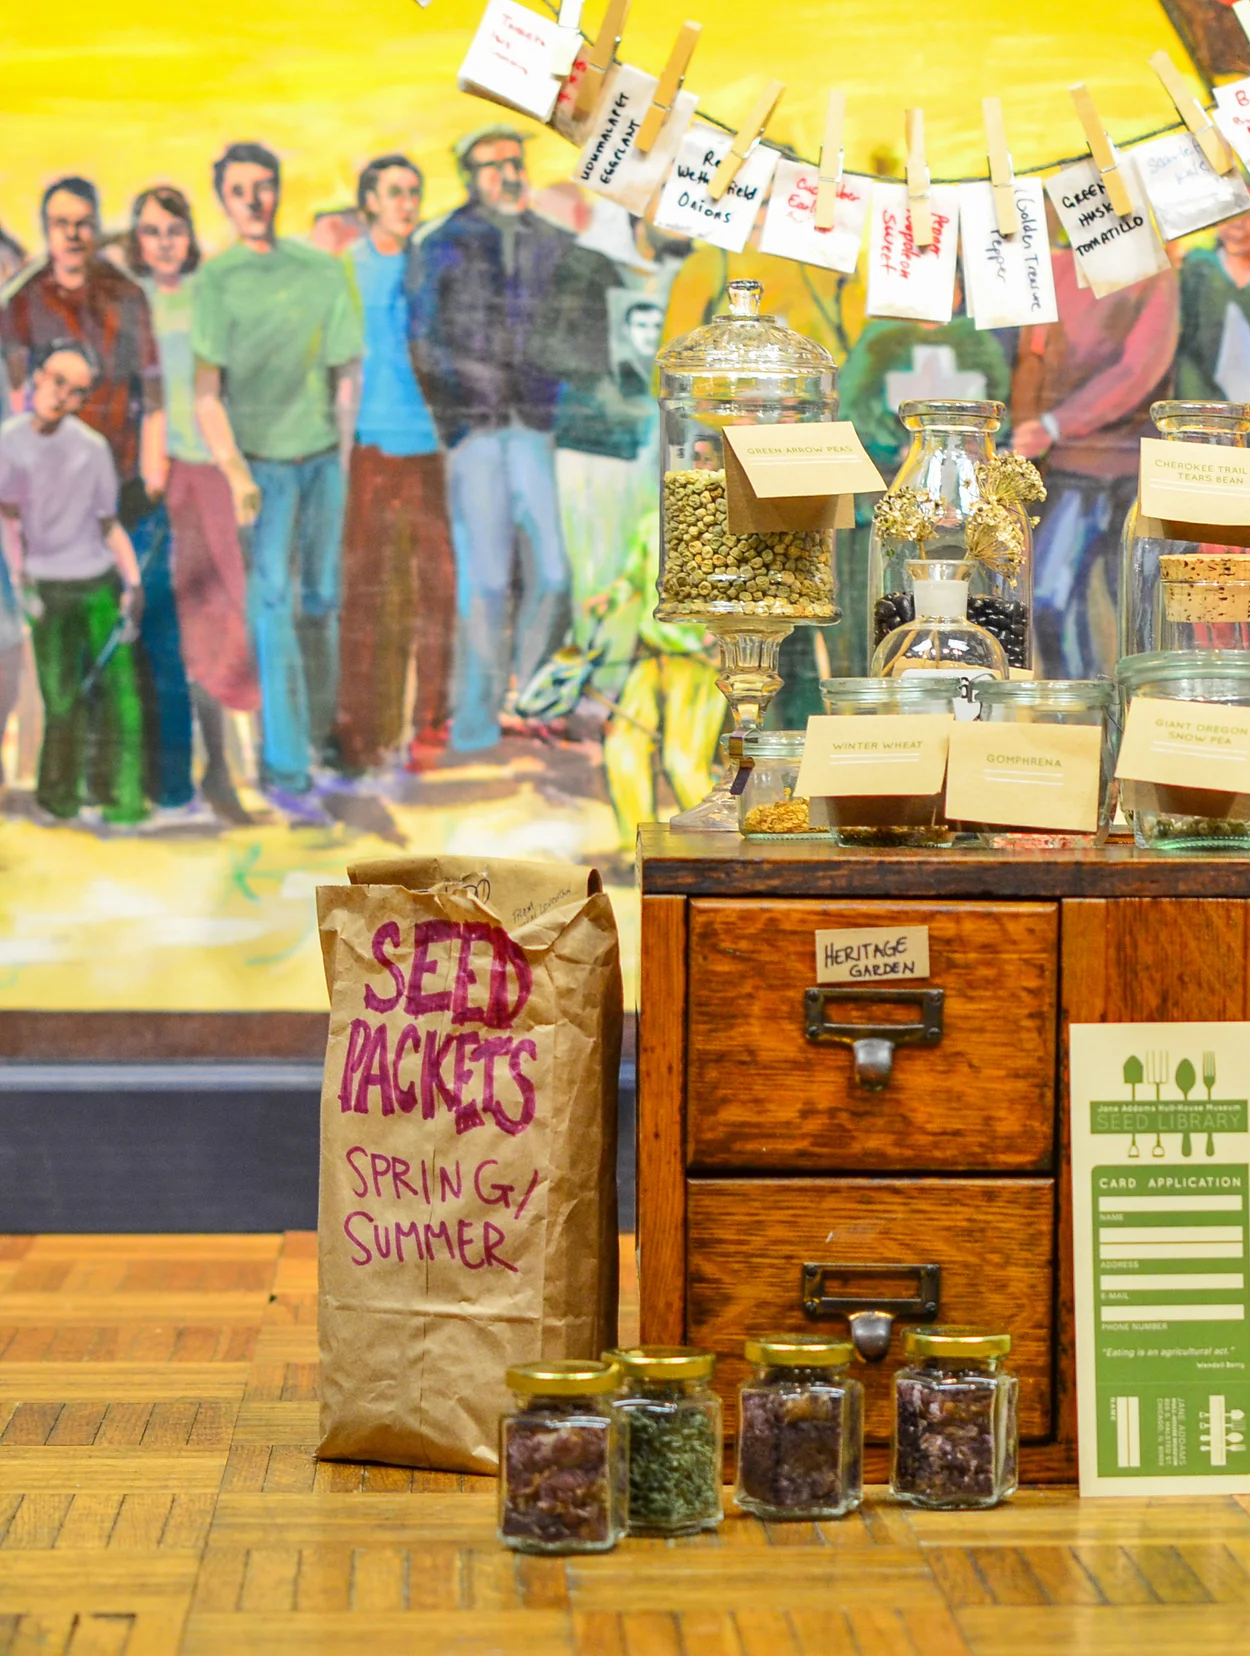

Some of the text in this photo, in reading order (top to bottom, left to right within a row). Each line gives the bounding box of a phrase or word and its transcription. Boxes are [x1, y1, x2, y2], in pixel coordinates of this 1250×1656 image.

[599, 119, 640, 184] EGGPLANT
[677, 191, 731, 223] Onions
[1078, 202, 1114, 227] HUSK
[1015, 197, 1038, 249] Golden
[880, 208, 897, 274] Sweet
[1075, 215, 1144, 256] TOMATILLO
[747, 444, 854, 456] GREEN ARROW PEAS
[1155, 459, 1213, 472] CHEROKEE
[1218, 466, 1248, 475] TRAIL
[1178, 472, 1244, 485] TEARS BEAN
[1155, 718, 1249, 736] GIANT OREGON
[833, 740, 925, 751] WINTER WHEAT
[1168, 731, 1233, 745] SNOW PEA
[986, 753, 1062, 768] GOMPHRENA
[824, 936, 908, 969] HERITAGE
[364, 919, 533, 1029] SEED
[849, 961, 915, 978] GARDEN
[337, 1017, 537, 1136] PACKETS
[1098, 1103, 1119, 1112] Jane
[1121, 1103, 1156, 1112] Addams
[1205, 1103, 1242, 1111] Museum
[1097, 1112, 1240, 1131] SEED LIBRARY
[346, 1145, 538, 1220] SPRING/
[1100, 1176, 1242, 1188] CARD APPLICATION
[1100, 1213, 1124, 1221] NAME
[343, 1210, 519, 1273] SUMMER
[1102, 1322, 1168, 1331] PHONE NUMBER
[1137, 1348, 1145, 1356] is
[1160, 1347, 1212, 1357] agricultural
[1226, 1361, 1245, 1369] Berry
[1177, 1397, 1187, 1466] JANE ADDAMS
